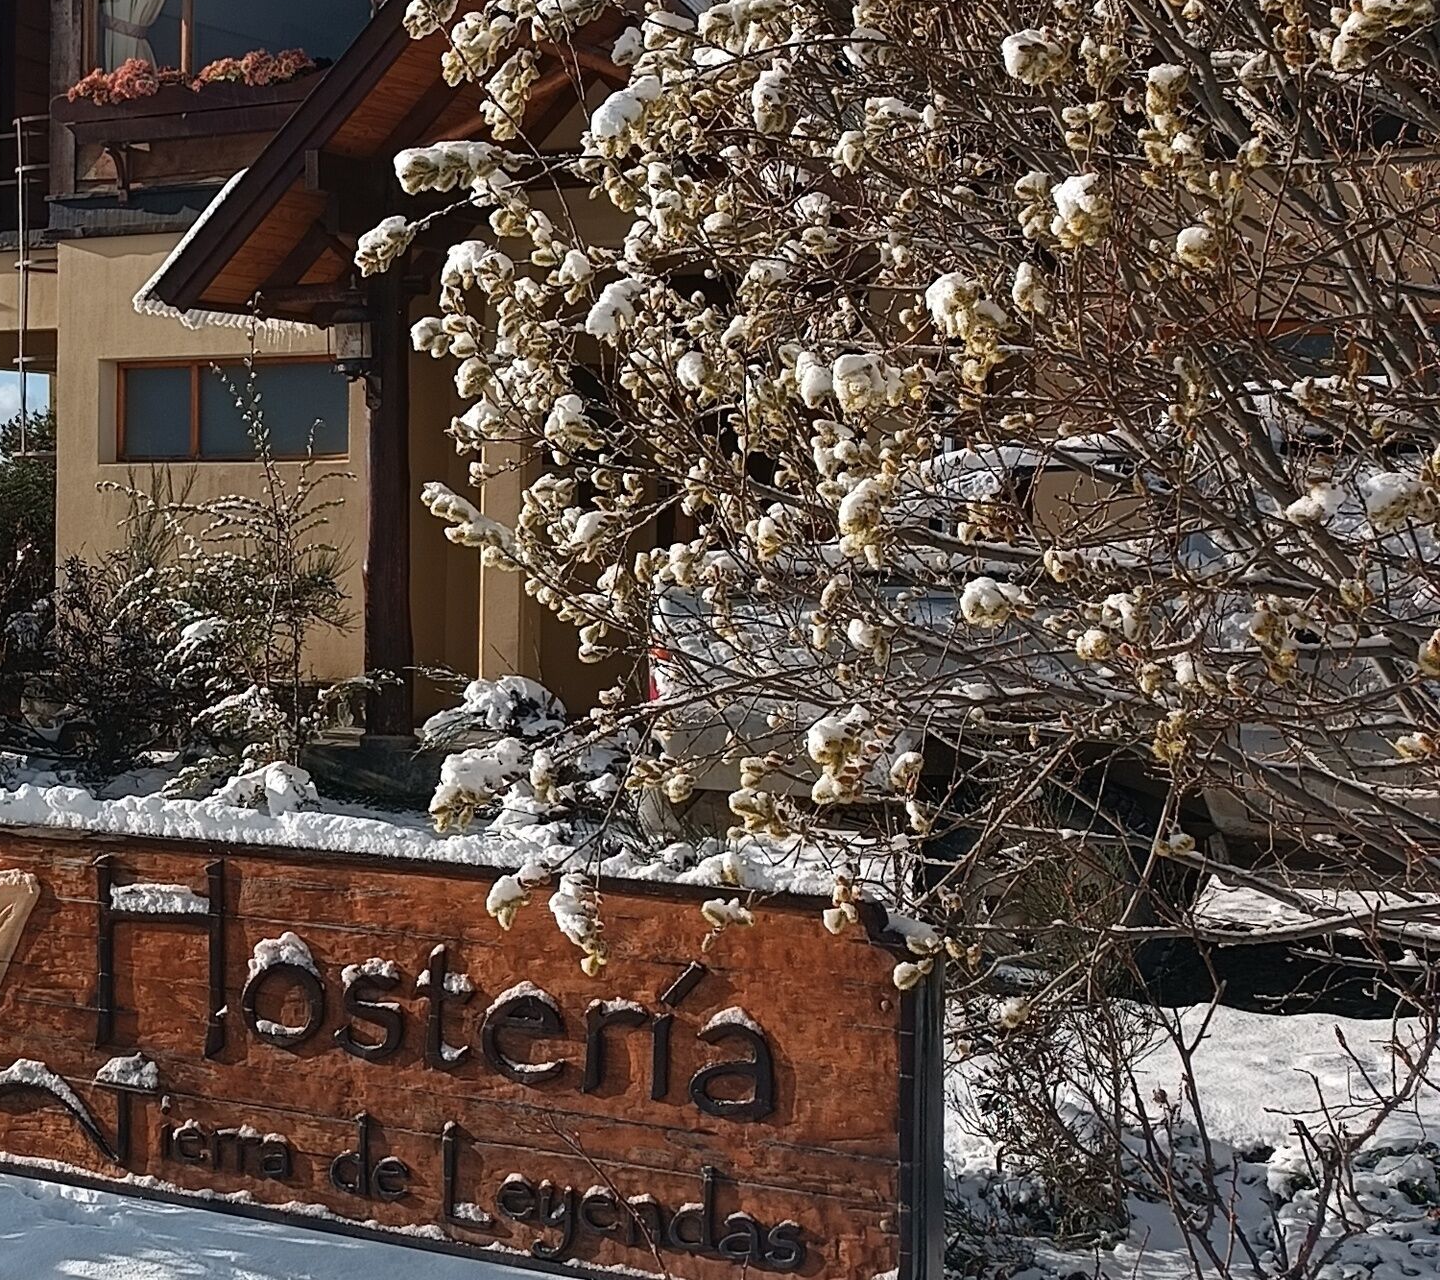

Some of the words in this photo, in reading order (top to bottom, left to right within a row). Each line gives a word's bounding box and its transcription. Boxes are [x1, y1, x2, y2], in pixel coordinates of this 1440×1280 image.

[92, 854, 776, 1119] Hostería
[94, 1058, 290, 1178] Tierra
[329, 1110, 410, 1202] de
[440, 1121, 807, 1269] Leyendas
